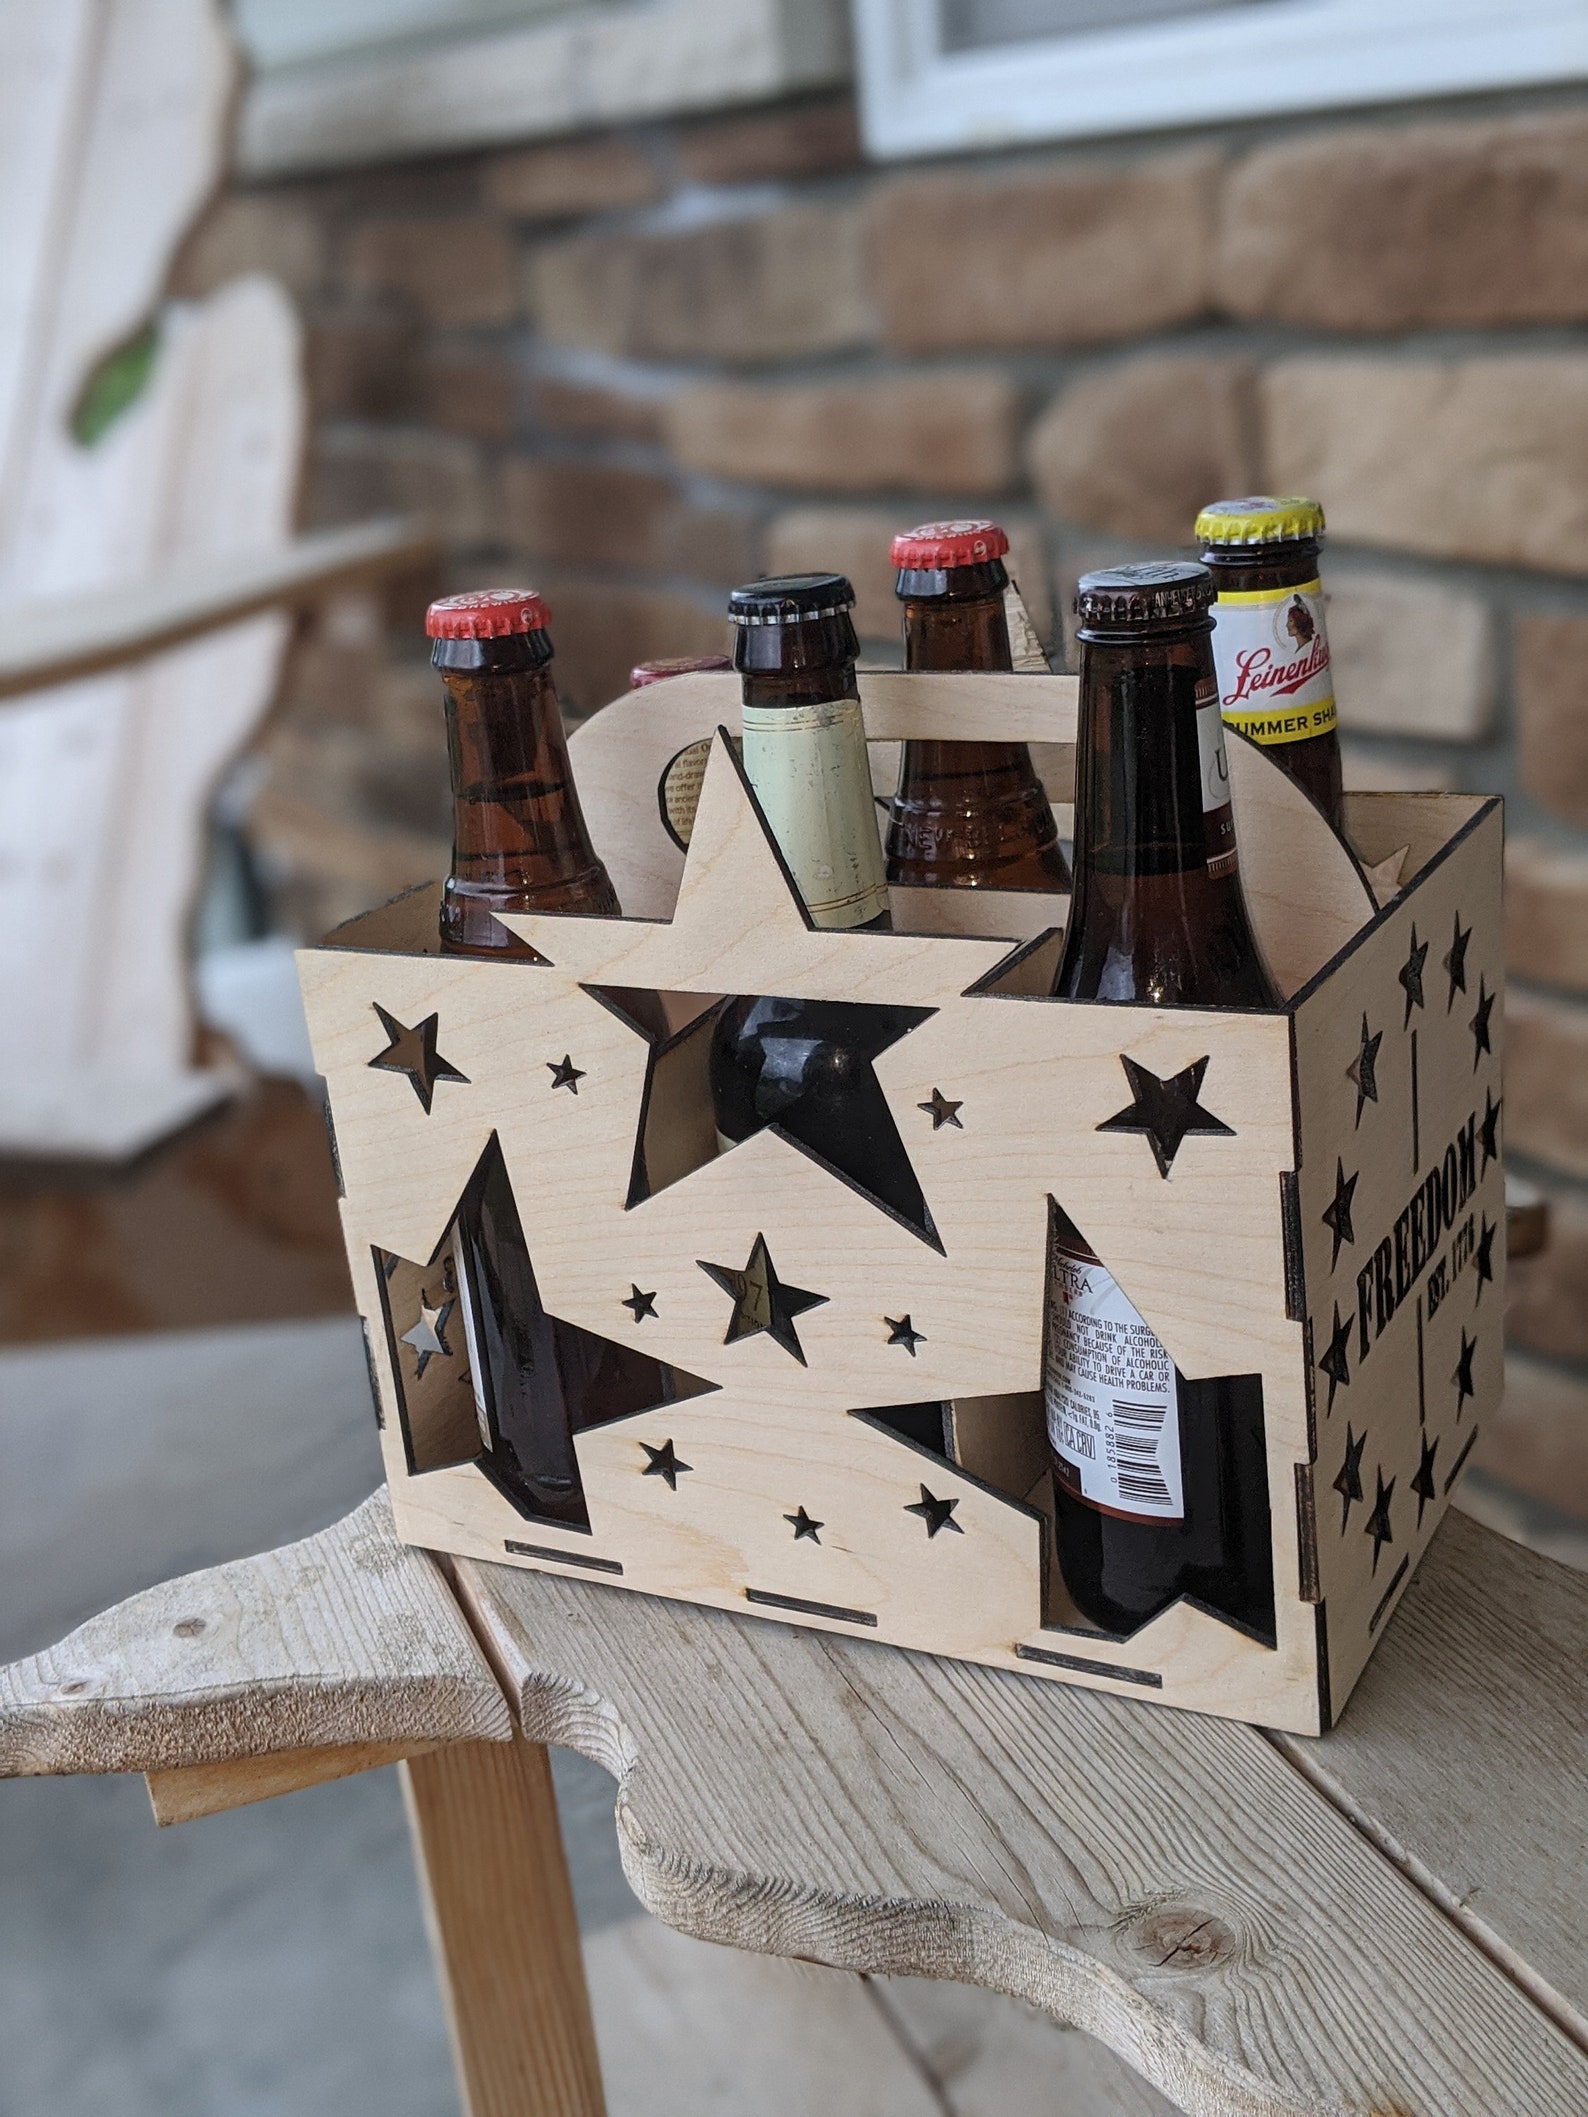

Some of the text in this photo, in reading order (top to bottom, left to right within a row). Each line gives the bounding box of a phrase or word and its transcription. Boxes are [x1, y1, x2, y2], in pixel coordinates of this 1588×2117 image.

[1357, 1111, 1476, 1365] FREEDOM
[1052, 1264, 1094, 1294] LTRA
[1069, 1310, 1103, 1330] ACCORDING
[1104, 1320, 1113, 1332] TO
[1114, 1322, 1128, 1335] THE
[1076, 1323, 1089, 1337] NOT
[1095, 1329, 1118, 1344] DRINK
[1124, 1335, 1163, 1348] ALCOHOL
[1063, 1338, 1108, 1363] CONSUMPTION
[1111, 1355, 1121, 1366] OF
[1126, 1357, 1170, 1371] ALCOHOLIC
[1083, 1336, 1113, 1354] BECAUSE
[1116, 1345, 1127, 1356] OF
[1131, 1346, 1145, 1359] THE
[1150, 1348, 1169, 1360] RISK
[1069, 1352, 1090, 1369] ABILITY
[1093, 1360, 1102, 1373] TO
[1105, 1364, 1127, 1379] DRIVE
[1130, 1369, 1136, 1379] A
[1139, 1370, 1155, 1381] CAR
[1158, 1372, 1170, 1382] OR
[1077, 1366, 1097, 1383] CAUSE
[1098, 1373, 1125, 1389] HEALTH
[1126, 1379, 1171, 1394] PROBLEMS.
